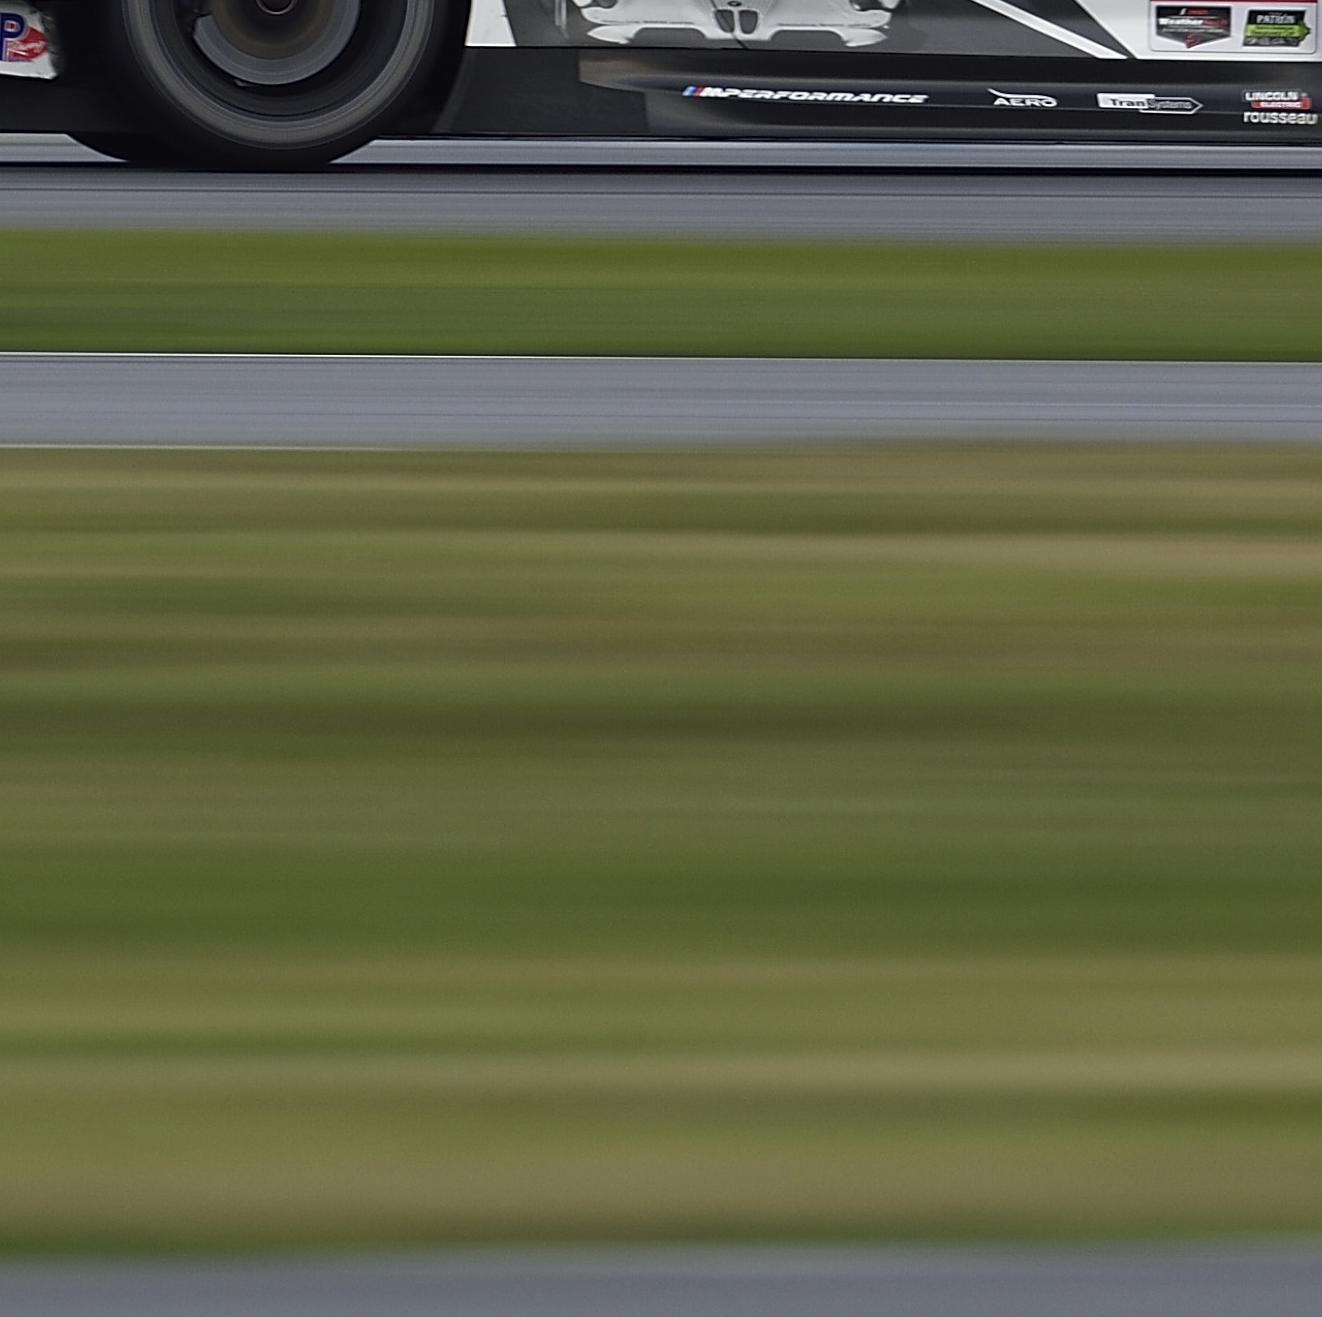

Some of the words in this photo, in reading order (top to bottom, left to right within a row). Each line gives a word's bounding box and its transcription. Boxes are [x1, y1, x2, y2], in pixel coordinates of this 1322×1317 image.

[1245, 91, 1299, 101] LINCOLN
[993, 97, 1058, 108] AERO
[1243, 111, 1319, 125] rousseau
